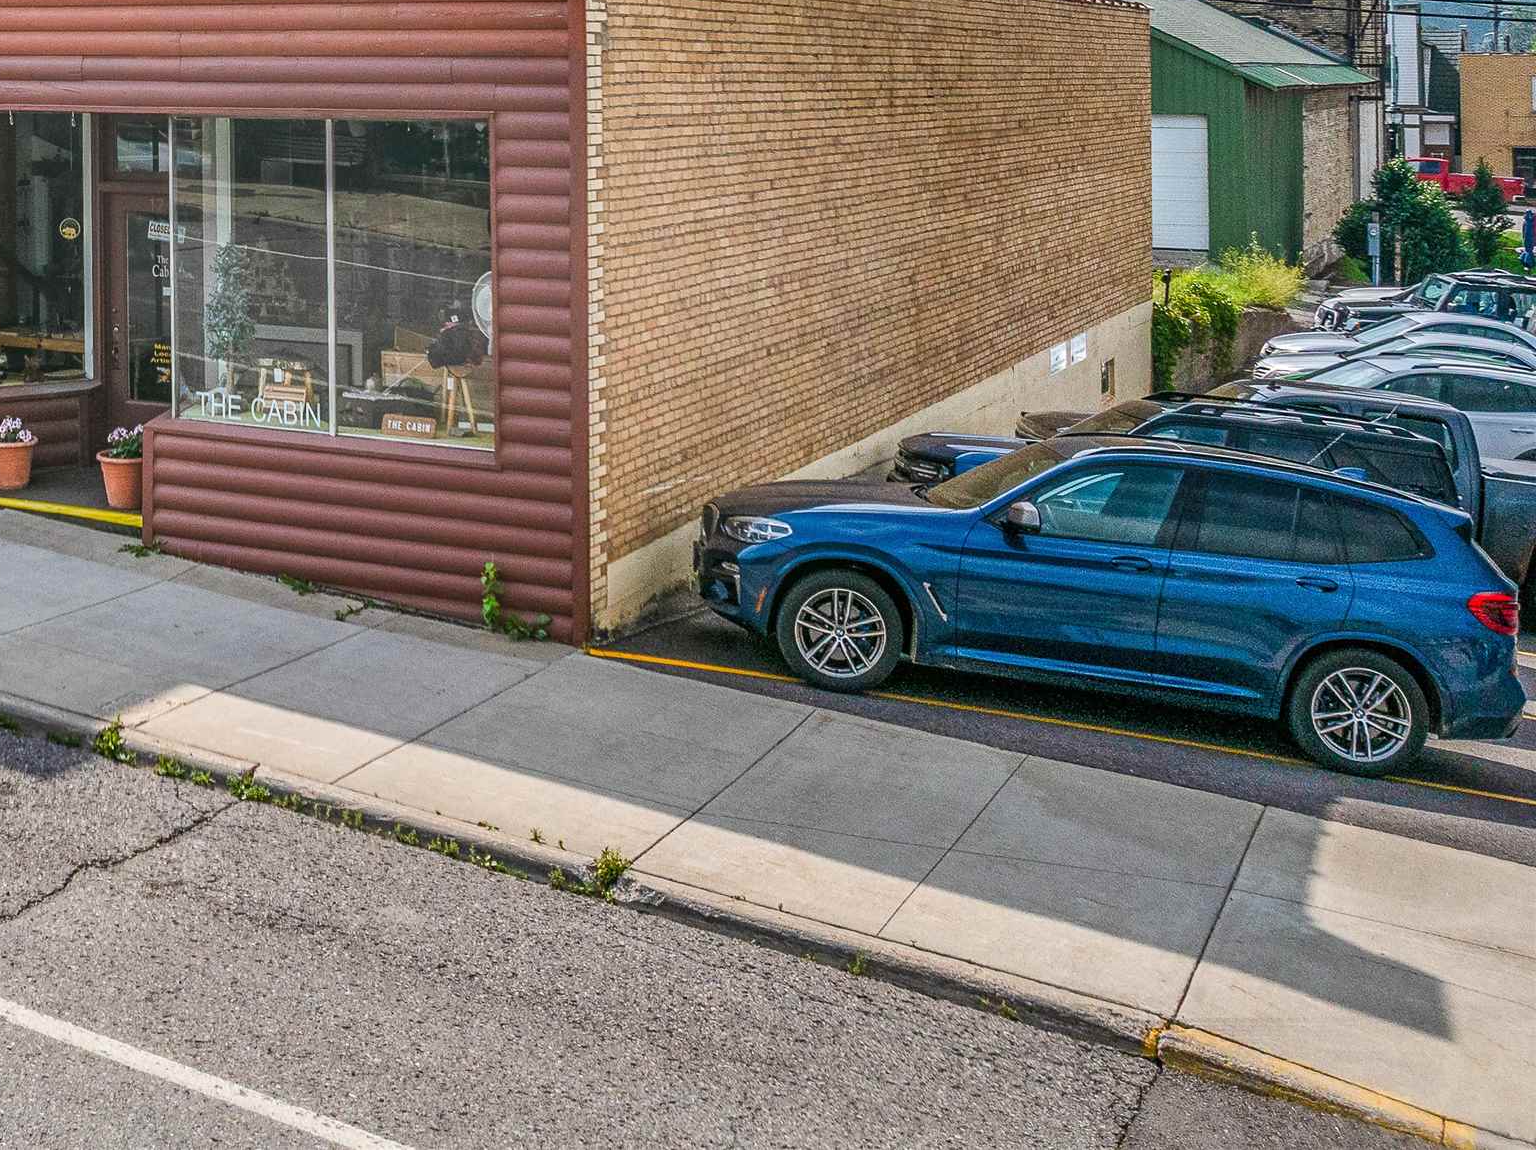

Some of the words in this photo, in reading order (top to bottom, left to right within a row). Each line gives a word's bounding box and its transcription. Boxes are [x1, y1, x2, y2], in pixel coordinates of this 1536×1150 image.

[149, 223, 170, 236] CLOSE
[152, 264, 170, 278] Cab
[196, 391, 241, 421] THE
[251, 397, 321, 428] CABIN
[387, 419, 402, 430] THE
[406, 420, 431, 434] CABIN
